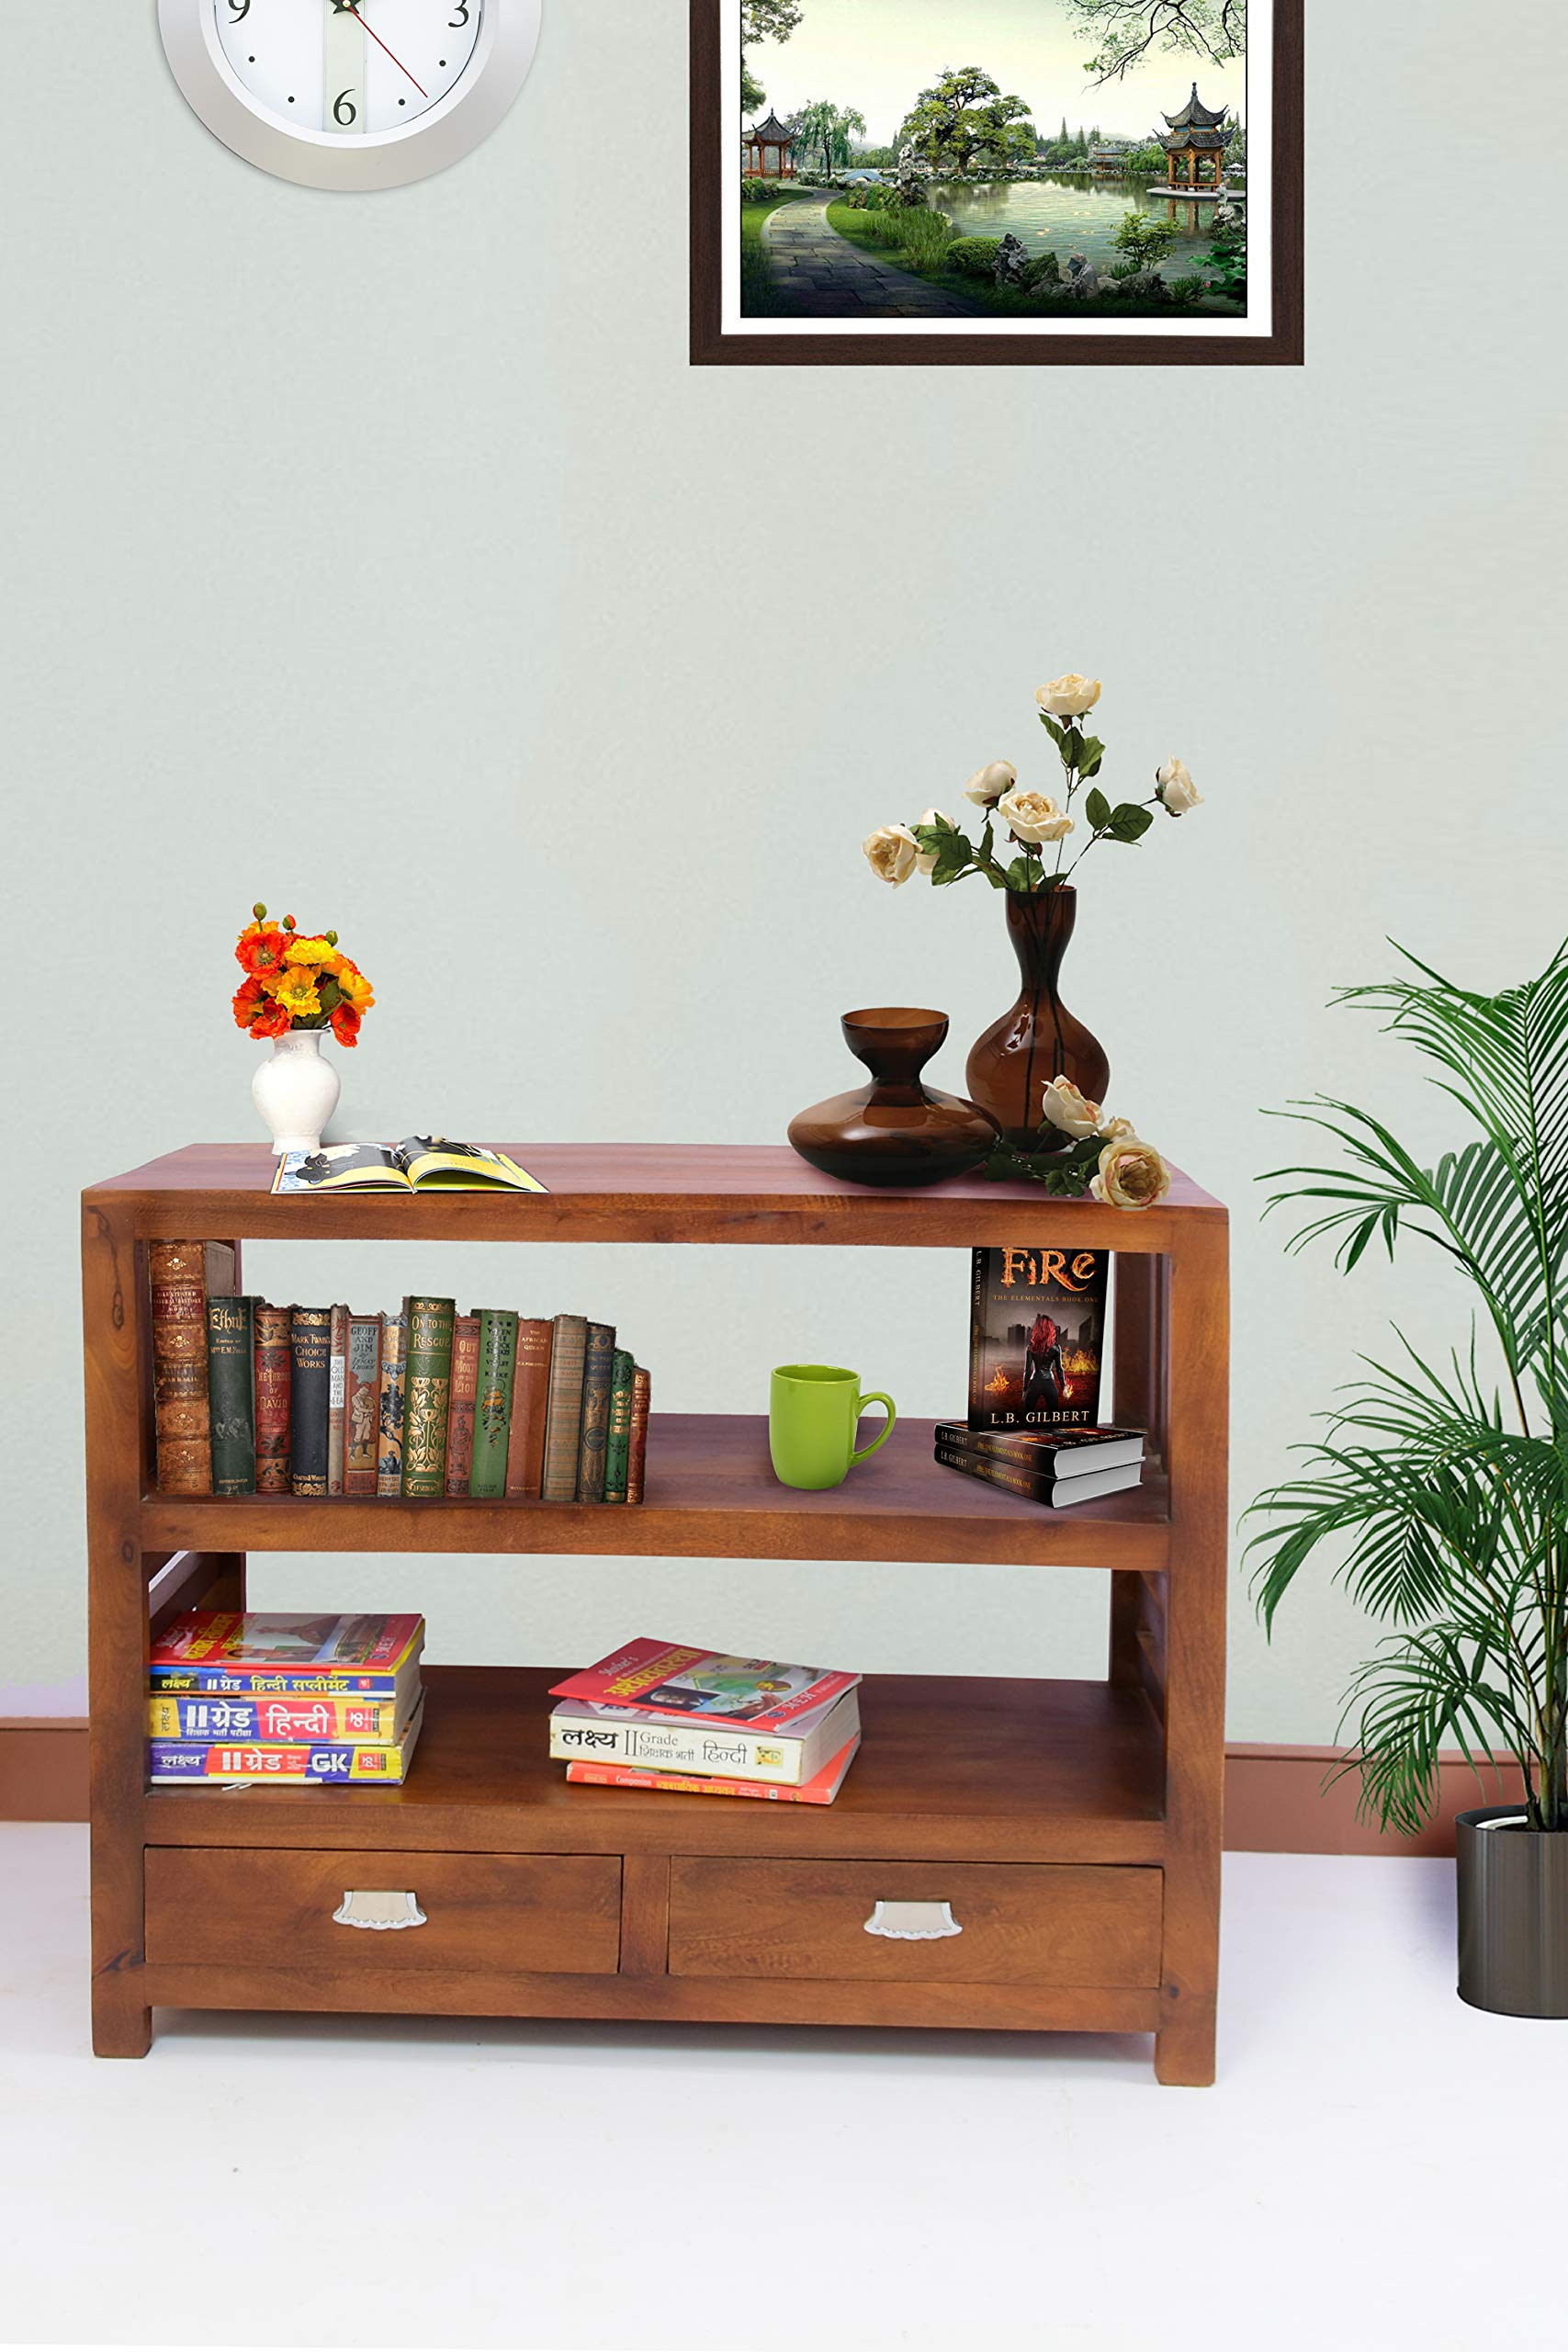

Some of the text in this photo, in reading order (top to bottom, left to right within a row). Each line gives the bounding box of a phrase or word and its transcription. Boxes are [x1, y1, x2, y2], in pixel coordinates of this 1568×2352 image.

[447, 0, 469, 28] 3
[333, 88, 356, 126] 6
[974, 1269, 982, 1306] GILBERT
[351, 1326, 378, 1335] GEOFF
[291, 1333, 309, 1344] MARK
[413, 1333, 451, 1349] RESCUE
[295, 1345, 327, 1357] CHOICE
[354, 1344, 373, 1352] JIM
[459, 1340, 477, 1353] OUT
[297, 1357, 325, 1369] WORKS
[260, 1396, 288, 1410] DAVID
[991, 1410, 1089, 1424] L.B. GILBERT
[949, 1433, 967, 1446] GILBERT
[949, 1453, 966, 1466] GILBERT
[161, 1677, 192, 1689] लक्ष्य
[220, 1675, 242, 1690] ग्रेड
[250, 1675, 288, 1691] हिन्दी
[291, 1675, 350, 1691] सप्लीमेंट
[210, 1702, 253, 1728] ग्रेड
[265, 1701, 330, 1735] हिन्दी
[186, 1728, 210, 1737] शिक्षक
[561, 1728, 618, 1749] लक्ष्य
[639, 1732, 679, 1747] Grade
[703, 1739, 748, 1765] हिन्दी
[161, 1755, 201, 1767] लक्ष्य
[244, 1748, 283, 1770] ग्रेड
[311, 1753, 348, 1772] GK
[615, 1774, 652, 1787] Companion
